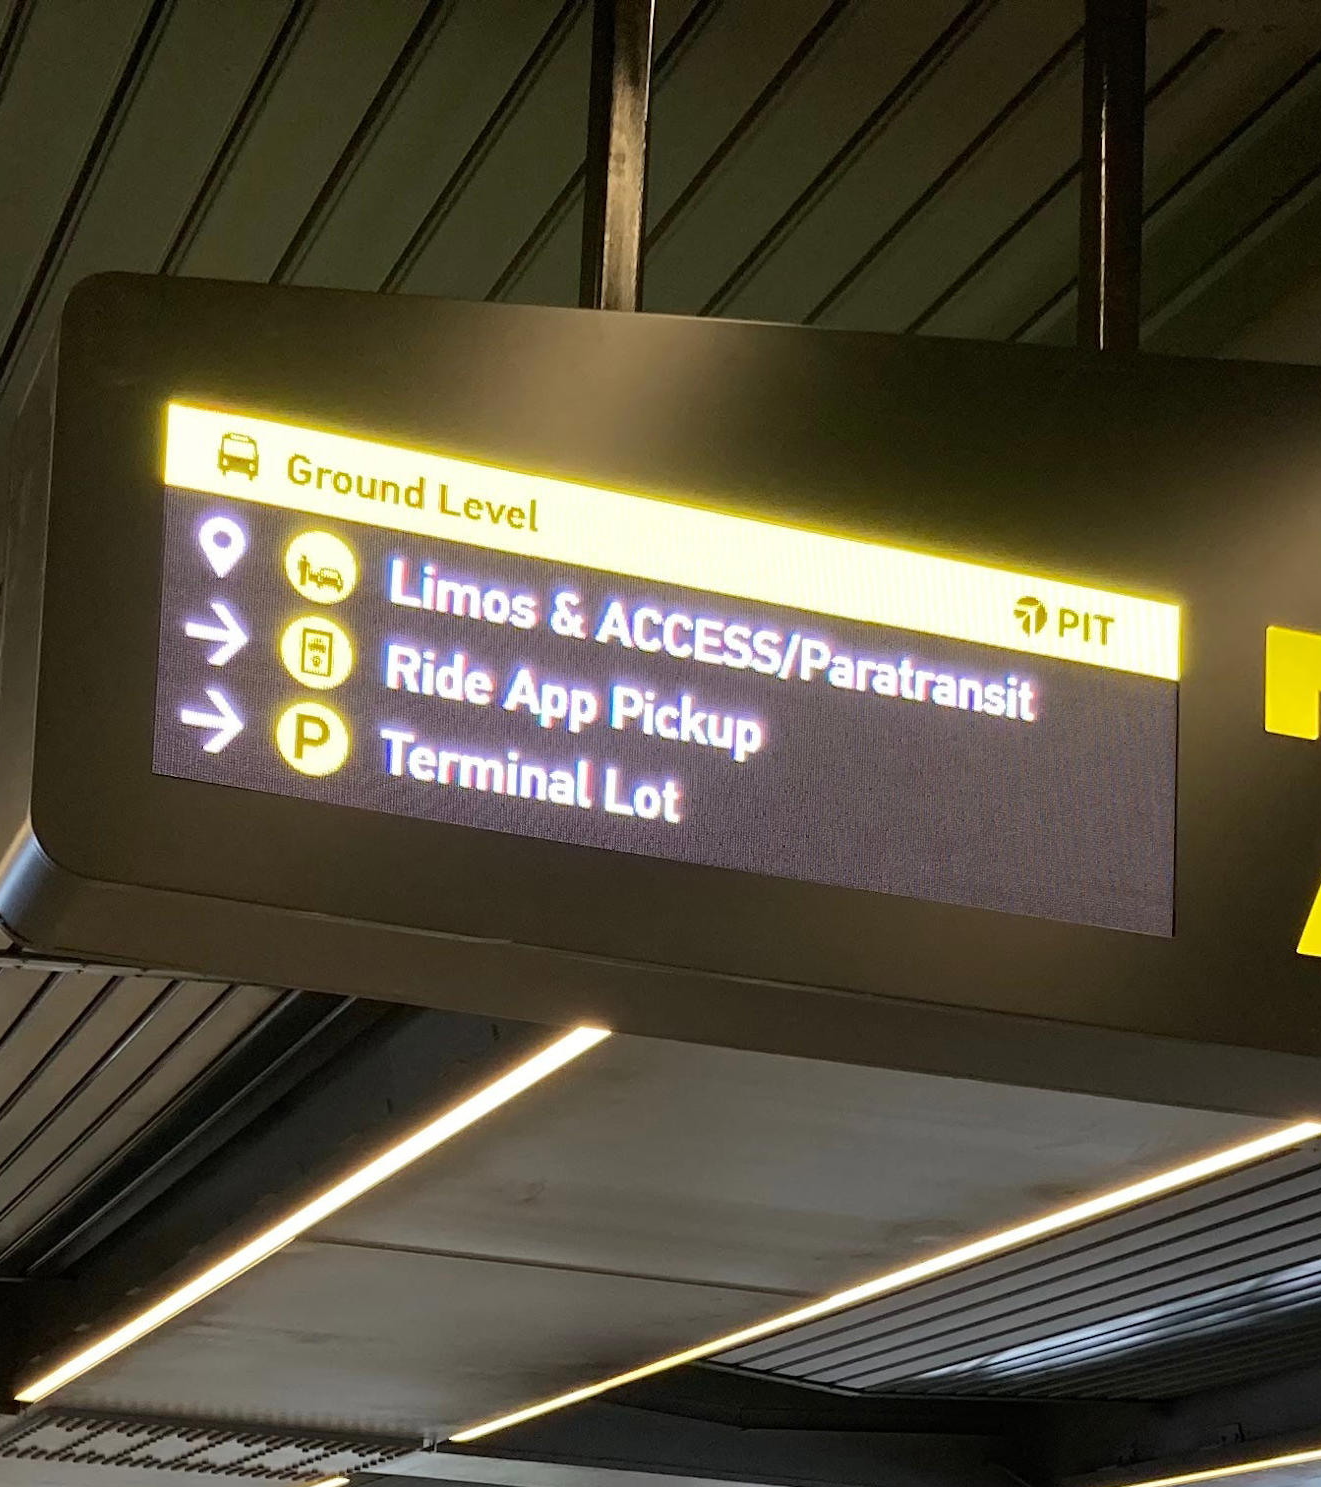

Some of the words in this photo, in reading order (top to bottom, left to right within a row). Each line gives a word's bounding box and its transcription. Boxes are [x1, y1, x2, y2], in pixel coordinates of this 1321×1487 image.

[287, 454, 426, 510] Ground
[439, 484, 540, 532] Level
[389, 556, 536, 631] Limos
[550, 591, 587, 640] &
[595, 600, 1038, 723] ACCESS/Paratransit
[1057, 606, 1116, 647] PIT
[385, 642, 494, 707] Ride
[503, 666, 598, 733] App
[611, 684, 763, 763] Pickup
[294, 713, 331, 760] P
[380, 728, 592, 810] Terminal
[604, 767, 682, 824] Lot
